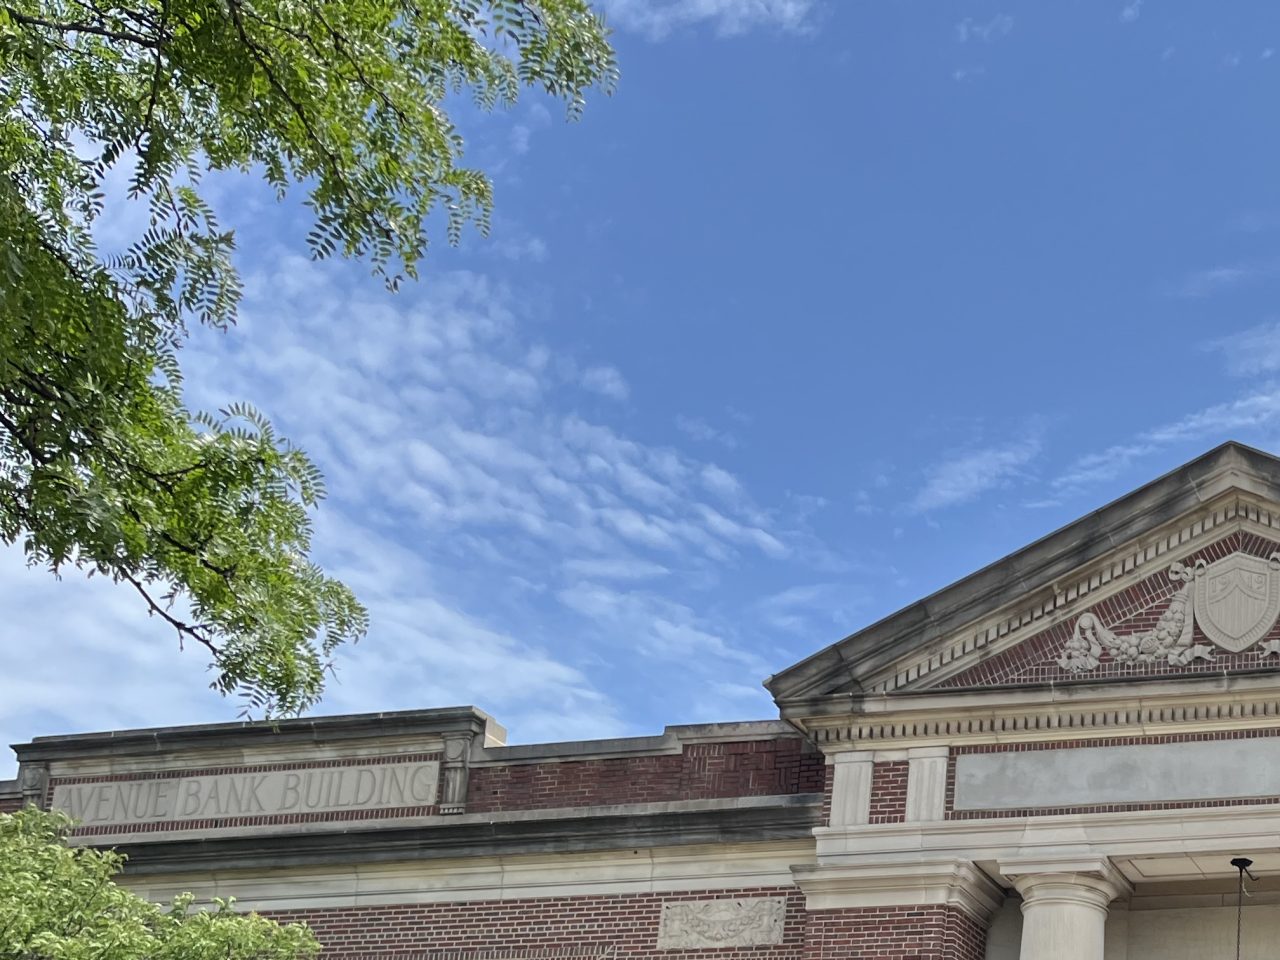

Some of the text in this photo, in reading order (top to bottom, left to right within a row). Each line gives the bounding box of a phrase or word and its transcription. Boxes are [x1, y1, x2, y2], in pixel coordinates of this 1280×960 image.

[60, 765, 434, 823] AVENUE BANK BUILDING
